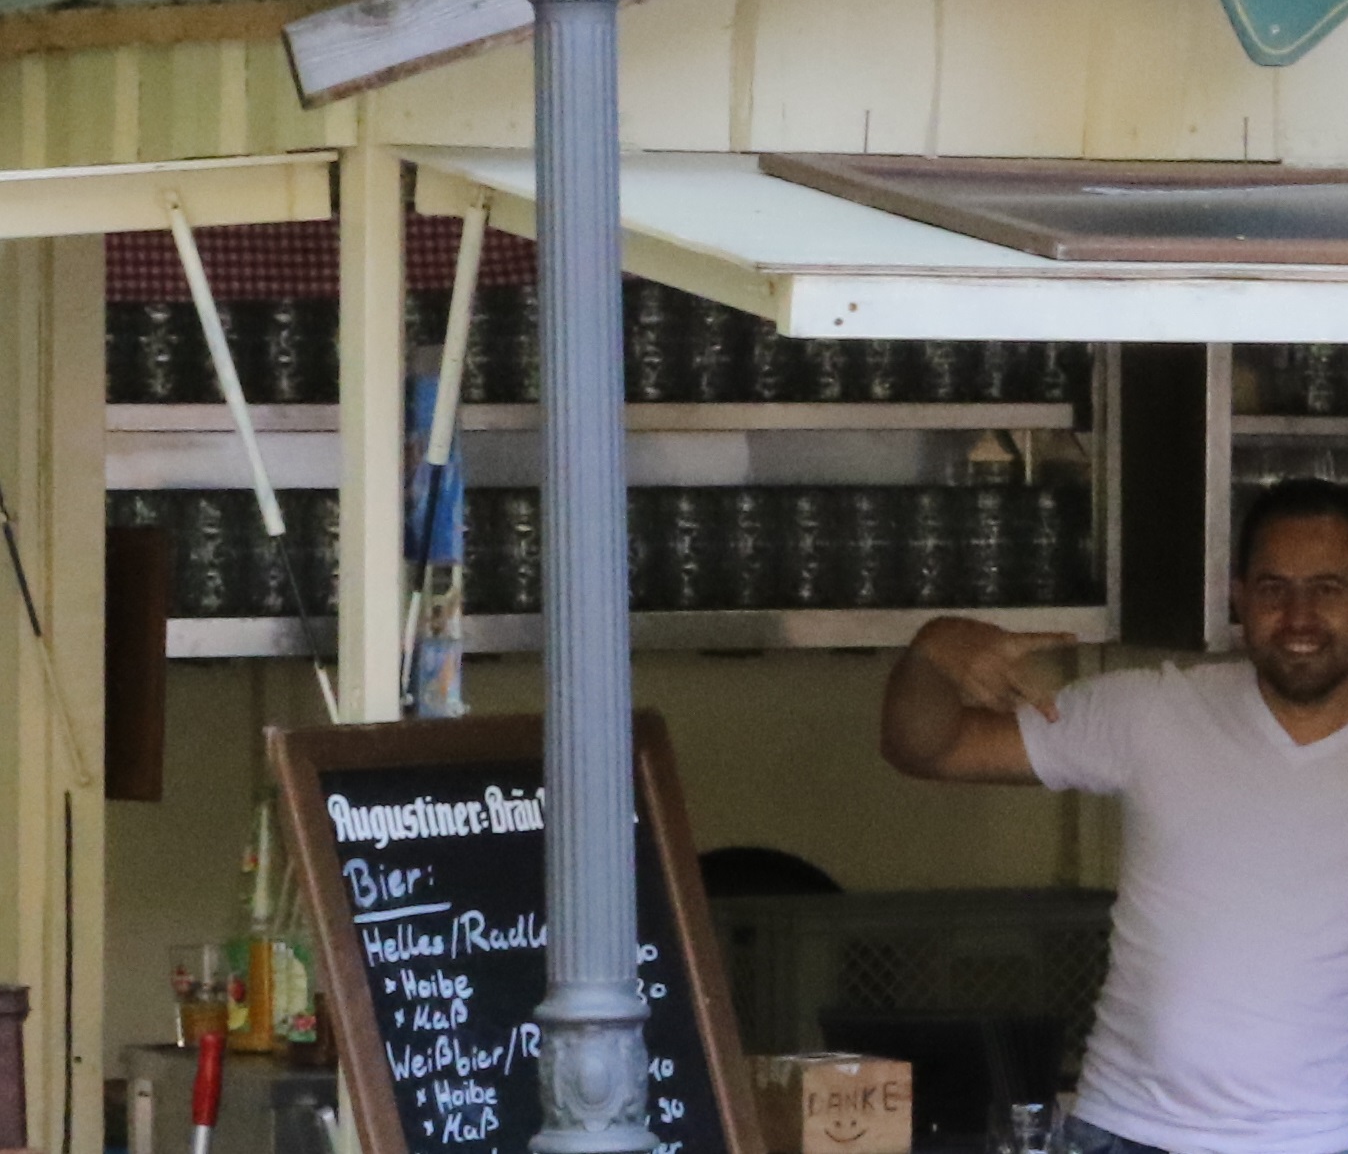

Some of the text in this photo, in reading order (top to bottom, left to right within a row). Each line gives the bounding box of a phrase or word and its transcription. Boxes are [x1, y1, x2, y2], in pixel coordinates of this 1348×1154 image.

[342, 857, 434, 908] Bier:
[413, 998, 469, 1032] Maß
[442, 1105, 499, 1144] Maß
